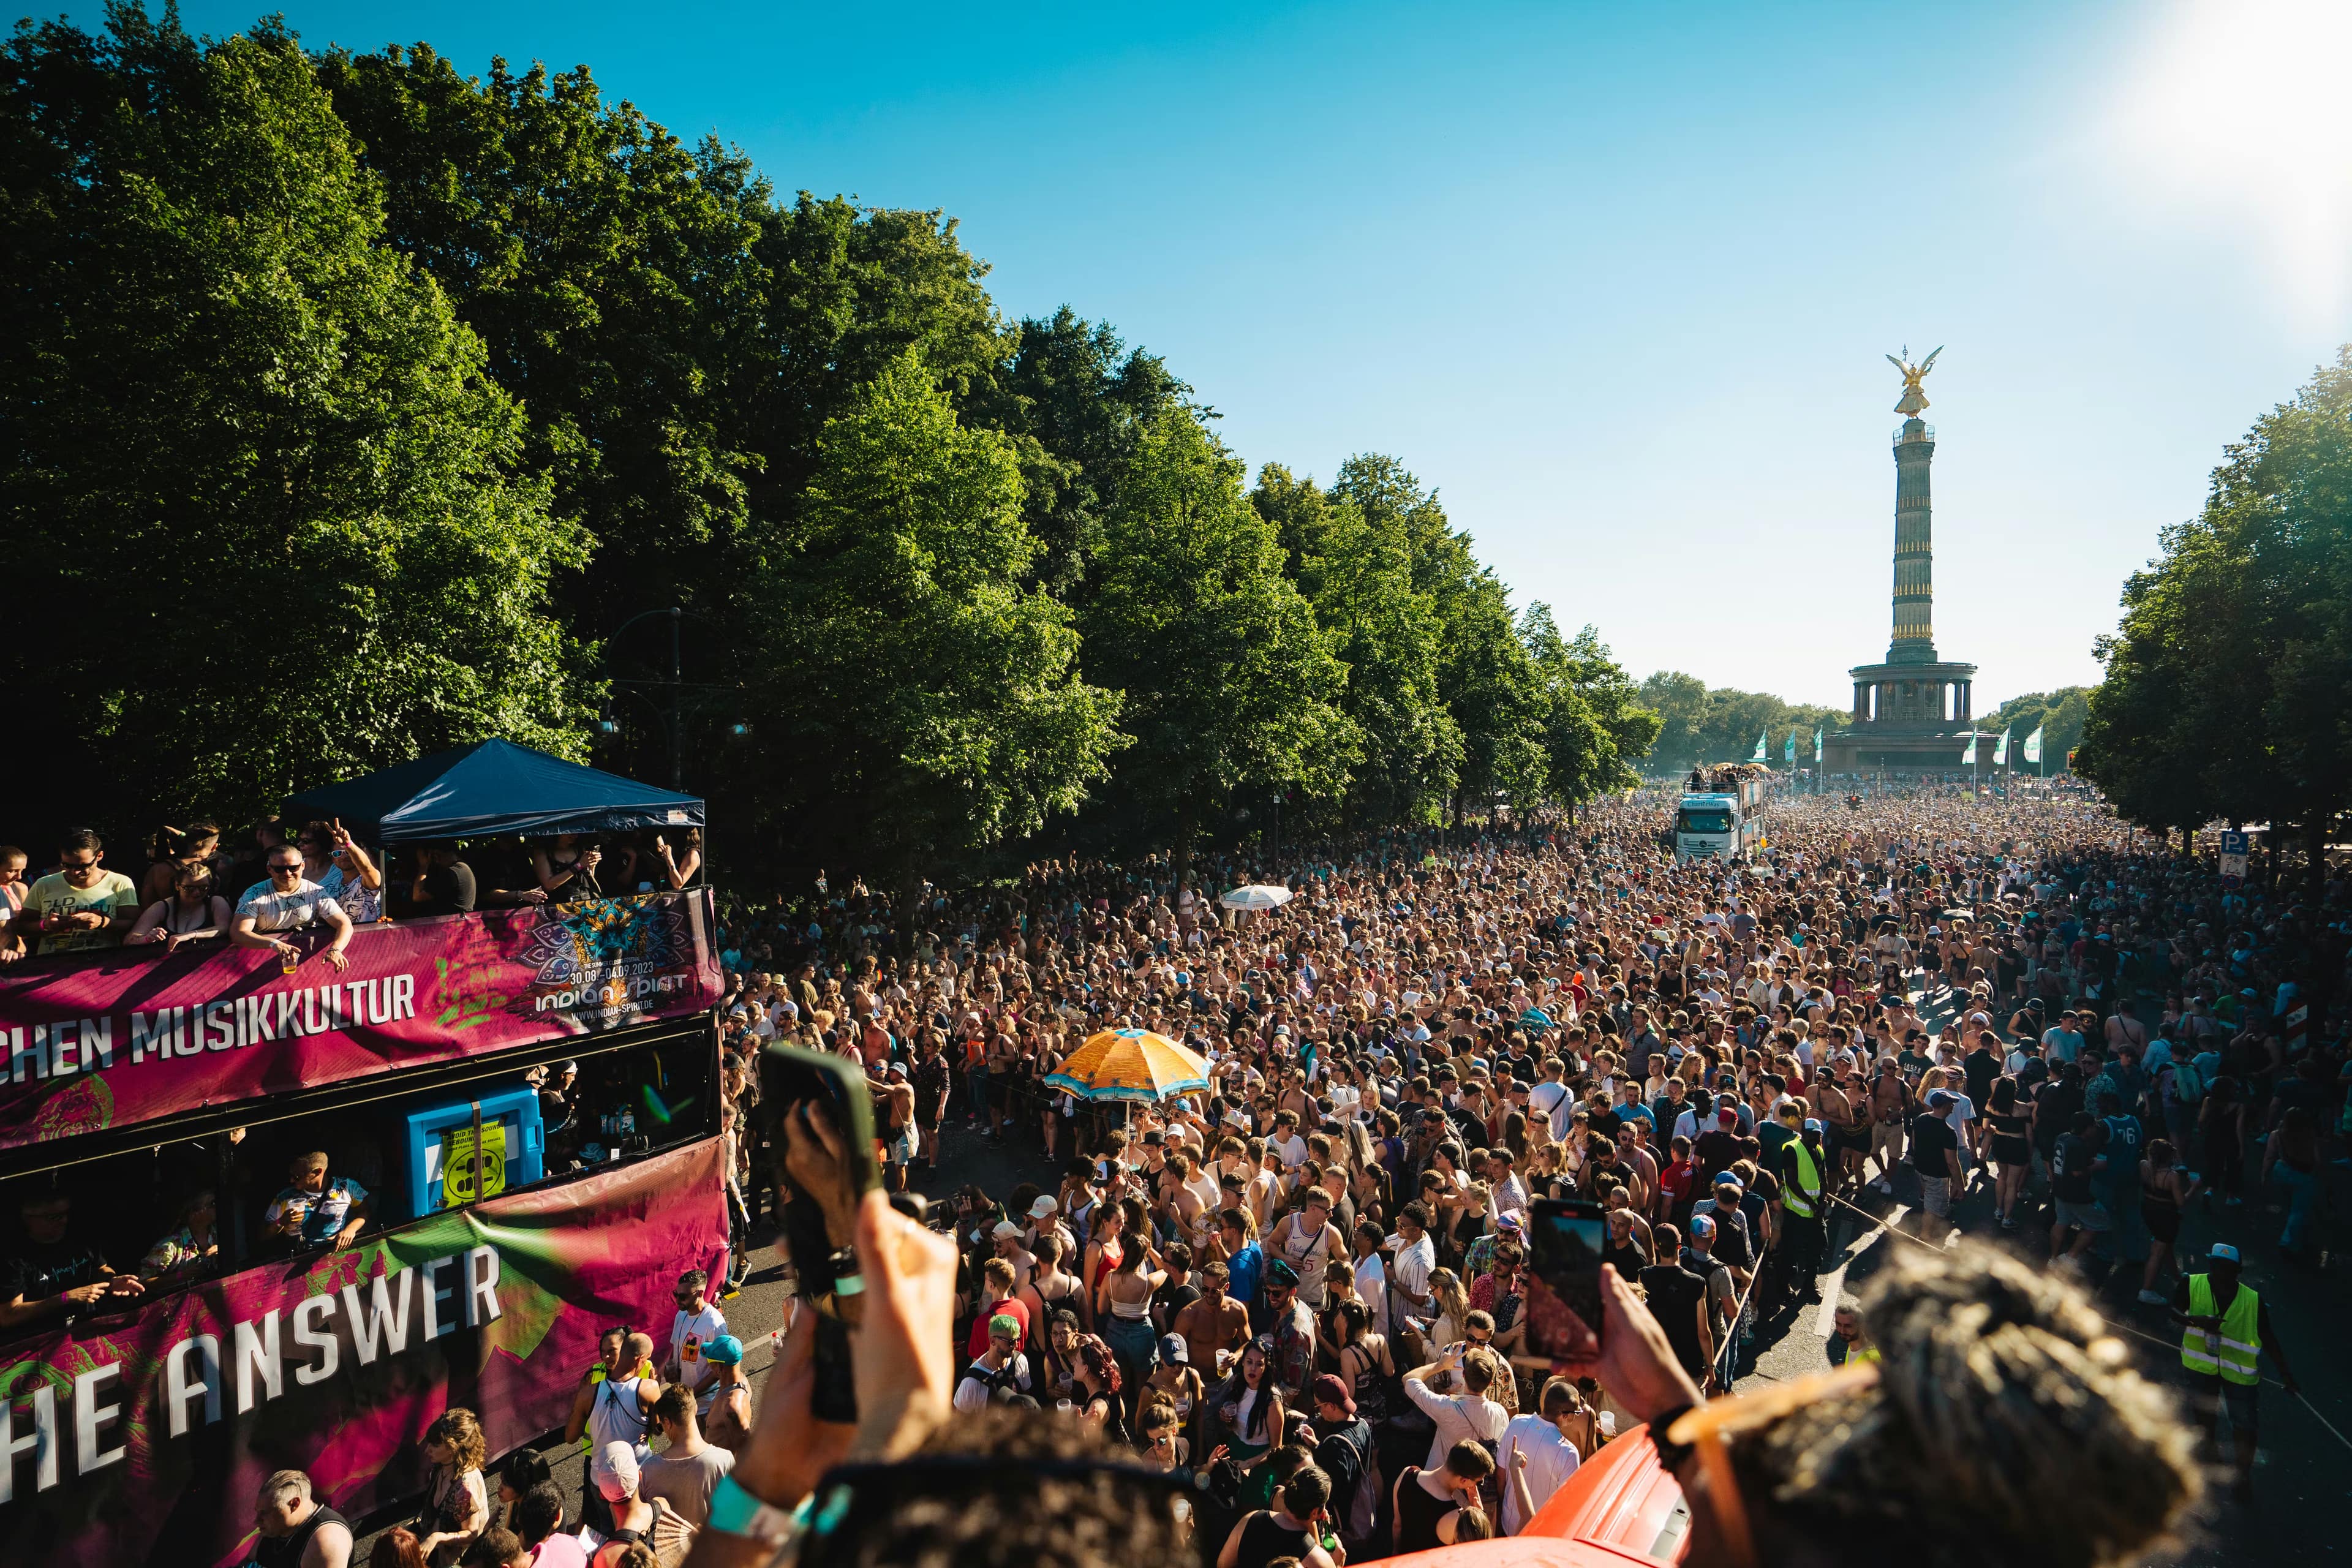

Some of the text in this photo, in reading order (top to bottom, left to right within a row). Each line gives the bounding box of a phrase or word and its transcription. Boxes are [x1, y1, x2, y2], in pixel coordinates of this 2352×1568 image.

[2225, 834, 2240, 851] P
[571, 1000, 654, 1022] WWW.INDIAN-SPIRIT.DE
[0, 974, 415, 1085] HEN MUSIKKULTUR
[169, 1244, 502, 1438] ANSWER
[1171, 1341, 1180, 1351] NY
